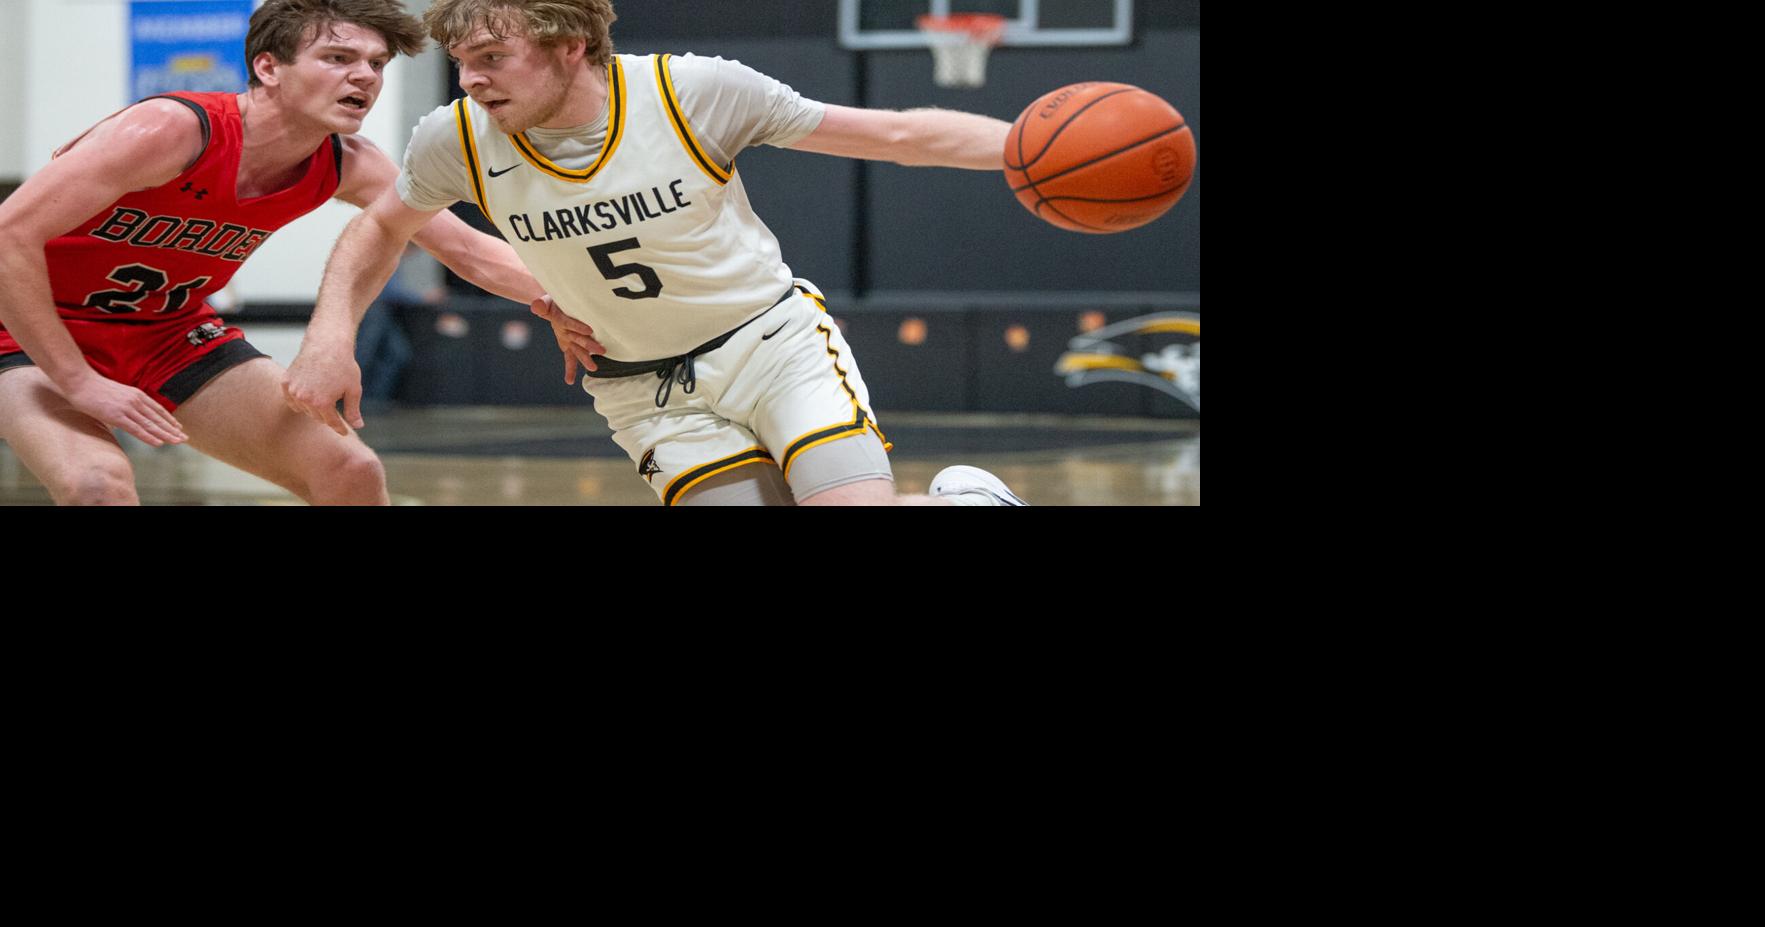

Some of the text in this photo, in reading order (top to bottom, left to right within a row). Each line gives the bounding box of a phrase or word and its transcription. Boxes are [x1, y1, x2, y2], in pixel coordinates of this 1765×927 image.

[508, 178, 692, 242] CLARKSVILLE
[82, 262, 213, 314] 21
[586, 237, 663, 300] 5
